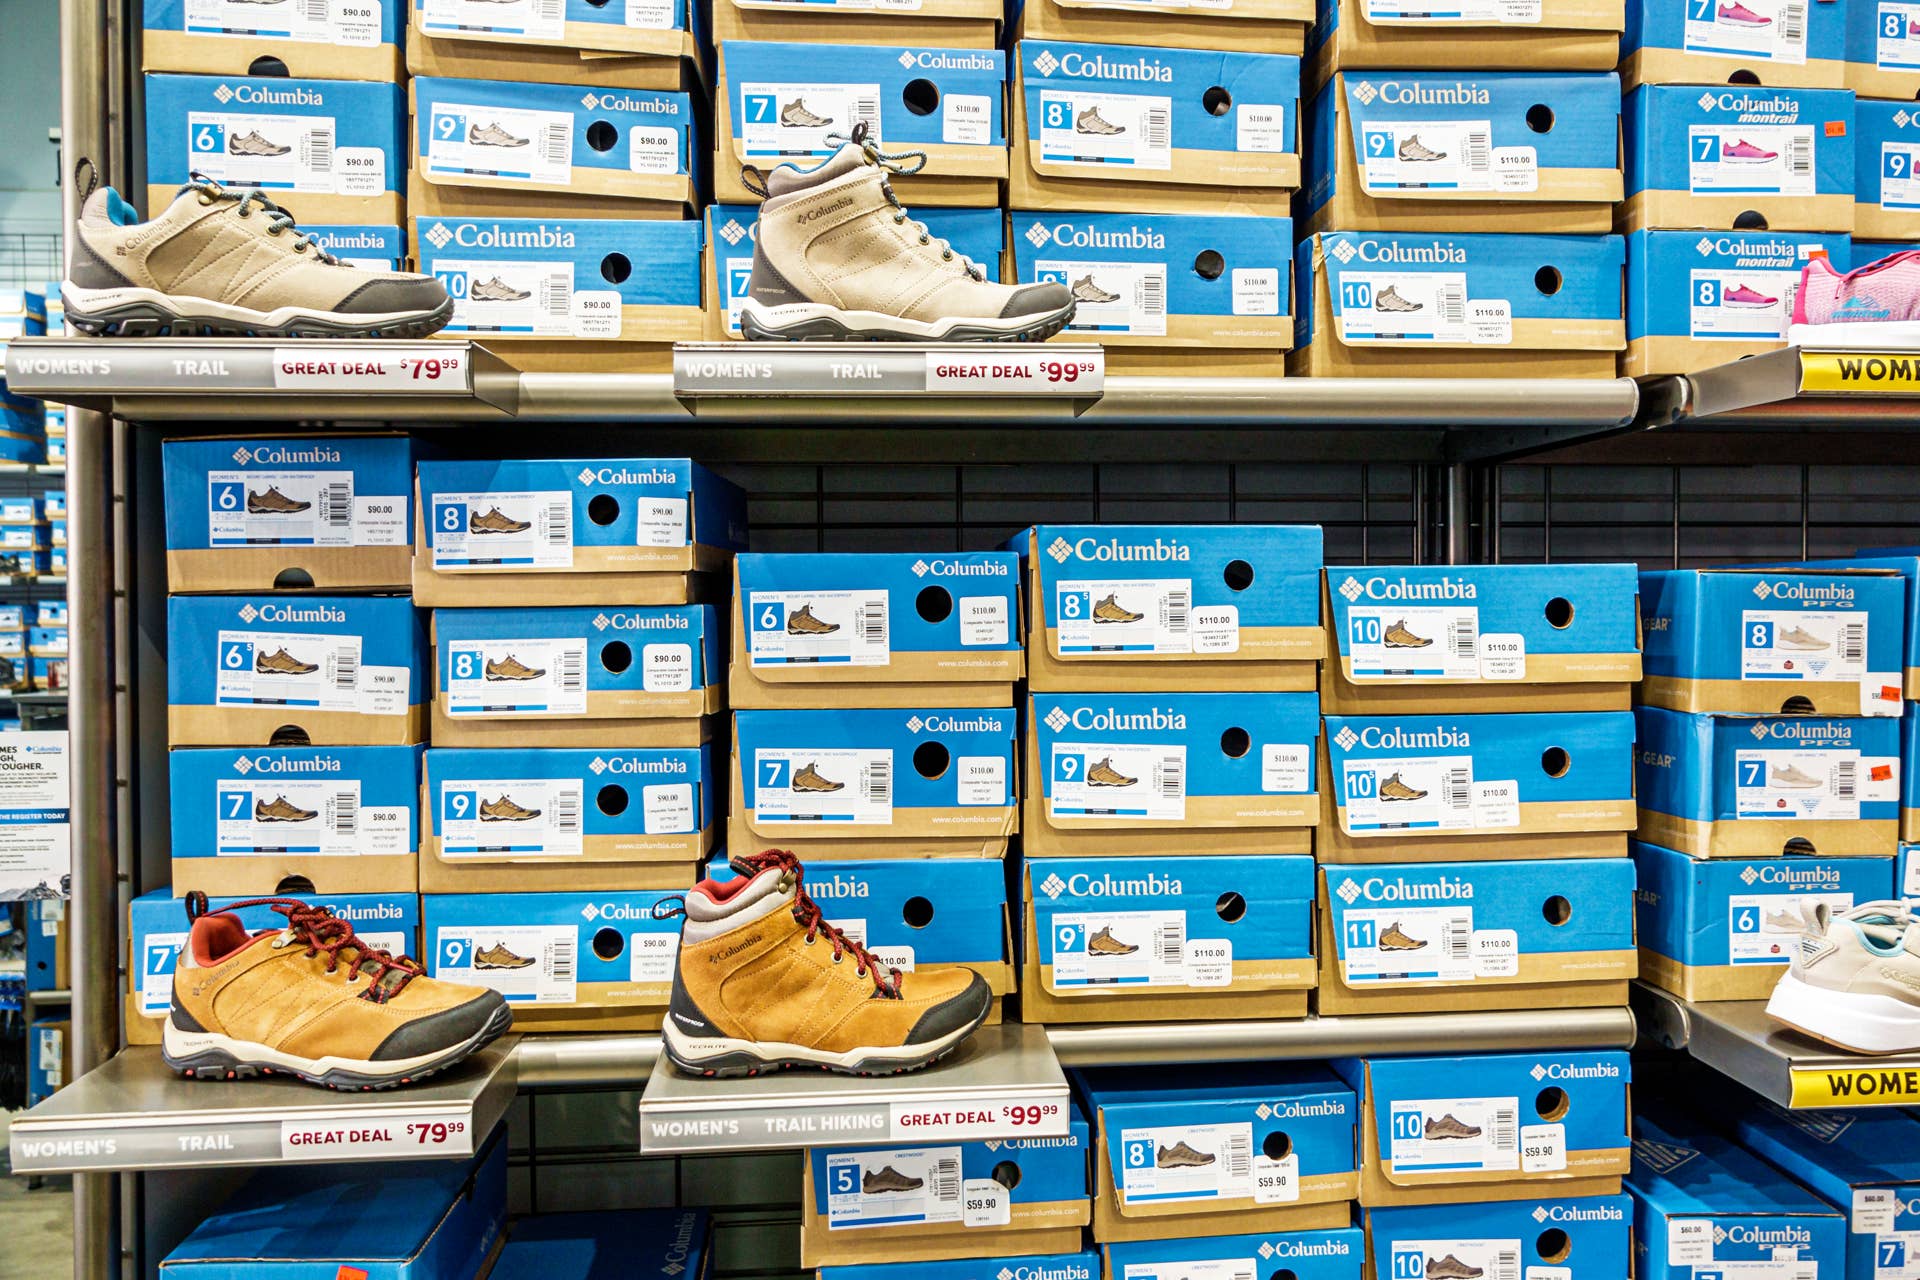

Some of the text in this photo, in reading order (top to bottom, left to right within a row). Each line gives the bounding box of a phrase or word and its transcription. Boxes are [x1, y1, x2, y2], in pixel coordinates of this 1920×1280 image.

[343, 9, 371, 17] $90.00
[917, 52, 994, 70] Columbia
[1061, 53, 1173, 82] Columbia
[235, 85, 323, 105] Columbia
[1379, 82, 1490, 105] Columbia
[600, 95, 678, 114] Columbia
[751, 98, 769, 121] 7
[955, 105, 980, 114] $110.00
[1718, 93, 1799, 113] Columbia
[1248, 115, 1273, 123] $110.00
[1738, 113, 1799, 125] montrail
[640, 137, 668, 146] $90.00
[1698, 139, 1713, 160] 7
[346, 158, 374, 167] $90.00
[1501, 156, 1530, 164] $110.00
[1889, 154, 1905, 176] 9
[807, 197, 854, 221] Columbia
[455, 223, 575, 249] Columbia
[1053, 224, 1165, 249] Columbia
[1358, 241, 1466, 264] Columbia
[1715, 238, 1794, 257] Columbia
[1736, 257, 1794, 268] montrail
[735, 273, 751, 295] 7
[1244, 278, 1267, 287] $110.00
[1344, 284, 1370, 307] 10
[1700, 282, 1714, 305] 8
[583, 301, 611, 309] $90.00
[15, 359, 111, 375] WOMEN'S
[172, 360, 229, 376] TRAIL
[282, 362, 337, 375] GREAT
[343, 363, 386, 375] DEAL
[685, 363, 772, 378] WOMEN'S
[830, 364, 882, 379] TRAIL
[936, 365, 988, 379] GREAT
[992, 365, 1032, 378] DEAL
[254, 447, 341, 464] Columbia
[597, 468, 676, 485] Columbia
[219, 487, 237, 509] 6
[368, 505, 392, 514] $90.00
[652, 508, 673, 516] $90.00
[443, 507, 460, 530] 8
[607, 552, 678, 561] www.columbia.com
[1076, 538, 1190, 561] Columbia
[930, 560, 1008, 576] Columbia
[1365, 577, 1477, 599] Columbia
[1773, 581, 1855, 600] Columbia
[972, 606, 996, 615] $110.00
[1803, 600, 1855, 608] PFG
[260, 604, 346, 622] Columbia
[611, 614, 689, 629] Columbia
[760, 606, 778, 629] 6
[1199, 616, 1230, 625] $110.00
[1353, 619, 1379, 642] 10
[1752, 624, 1767, 647] 8
[1488, 644, 1518, 652] $110.00
[654, 655, 682, 663] $90.00
[938, 659, 1009, 668] www.columbia.com
[374, 675, 395, 683] $90.00
[925, 717, 1002, 732] Columbia
[1071, 707, 1187, 731] Columbia
[1361, 726, 1470, 749] Columbia
[1771, 722, 1851, 739] Columbia
[1800, 739, 1851, 747] PFG
[255, 756, 341, 773] Columbia
[608, 757, 687, 774] Columbia
[1274, 754, 1298, 762] $110.00
[764, 763, 782, 785] 7
[970, 765, 994, 775] $110.00
[1061, 757, 1078, 780] 9
[1745, 763, 1760, 785] 7
[657, 794, 678, 802] $90.00
[1483, 789, 1508, 797] $110.00
[227, 795, 244, 817] 7
[452, 795, 469, 818] 9
[373, 813, 397, 821] $90.00
[932, 815, 1002, 824] www.columbia.com
[615, 842, 687, 850] www.columbia.com
[1759, 867, 1840, 883] Columbia
[1068, 873, 1182, 897] Columbia
[1363, 877, 1473, 901] Columbia
[1738, 910, 1753, 931] 6
[1349, 923, 1372, 946] 11
[644, 939, 667, 948] $90.00
[717, 935, 762, 961] Columbia
[1481, 940, 1511, 948] $110.00
[879, 957, 906, 965] 110.00
[1194, 949, 1225, 958] $110.00
[1548, 1063, 1619, 1079] Columbia
[1828, 1072, 1918, 1096] WOME
[1273, 1101, 1345, 1118] Columbia
[652, 1120, 739, 1137] WOMEN'S
[765, 1117, 816, 1133] TRAIL
[821, 1115, 884, 1131] HIKING
[900, 1112, 951, 1127] GREAT
[955, 1110, 995, 1124] DEAL
[1395, 1114, 1420, 1138] 10
[22, 1139, 116, 1158] WOMEN'S
[178, 1135, 234, 1151] TRAIL
[289, 1131, 344, 1145] GREAT
[350, 1129, 392, 1143] DEAL
[1525, 1146, 1553, 1157] $59.90
[837, 1168, 852, 1192] 5
[1258, 1176, 1287, 1187] $59.90
[967, 1198, 996, 1210] $59.90
[1012, 1206, 1080, 1217] www.columbia.com
[1550, 1206, 1623, 1222] Columbia
[666, 1213, 696, 1262] Columbia
[1729, 1225, 1811, 1243] Columbia
[1275, 1241, 1349, 1257] Columbia
[1015, 1265, 1089, 1280] Columbia
[1397, 1254, 1422, 1278] 10
